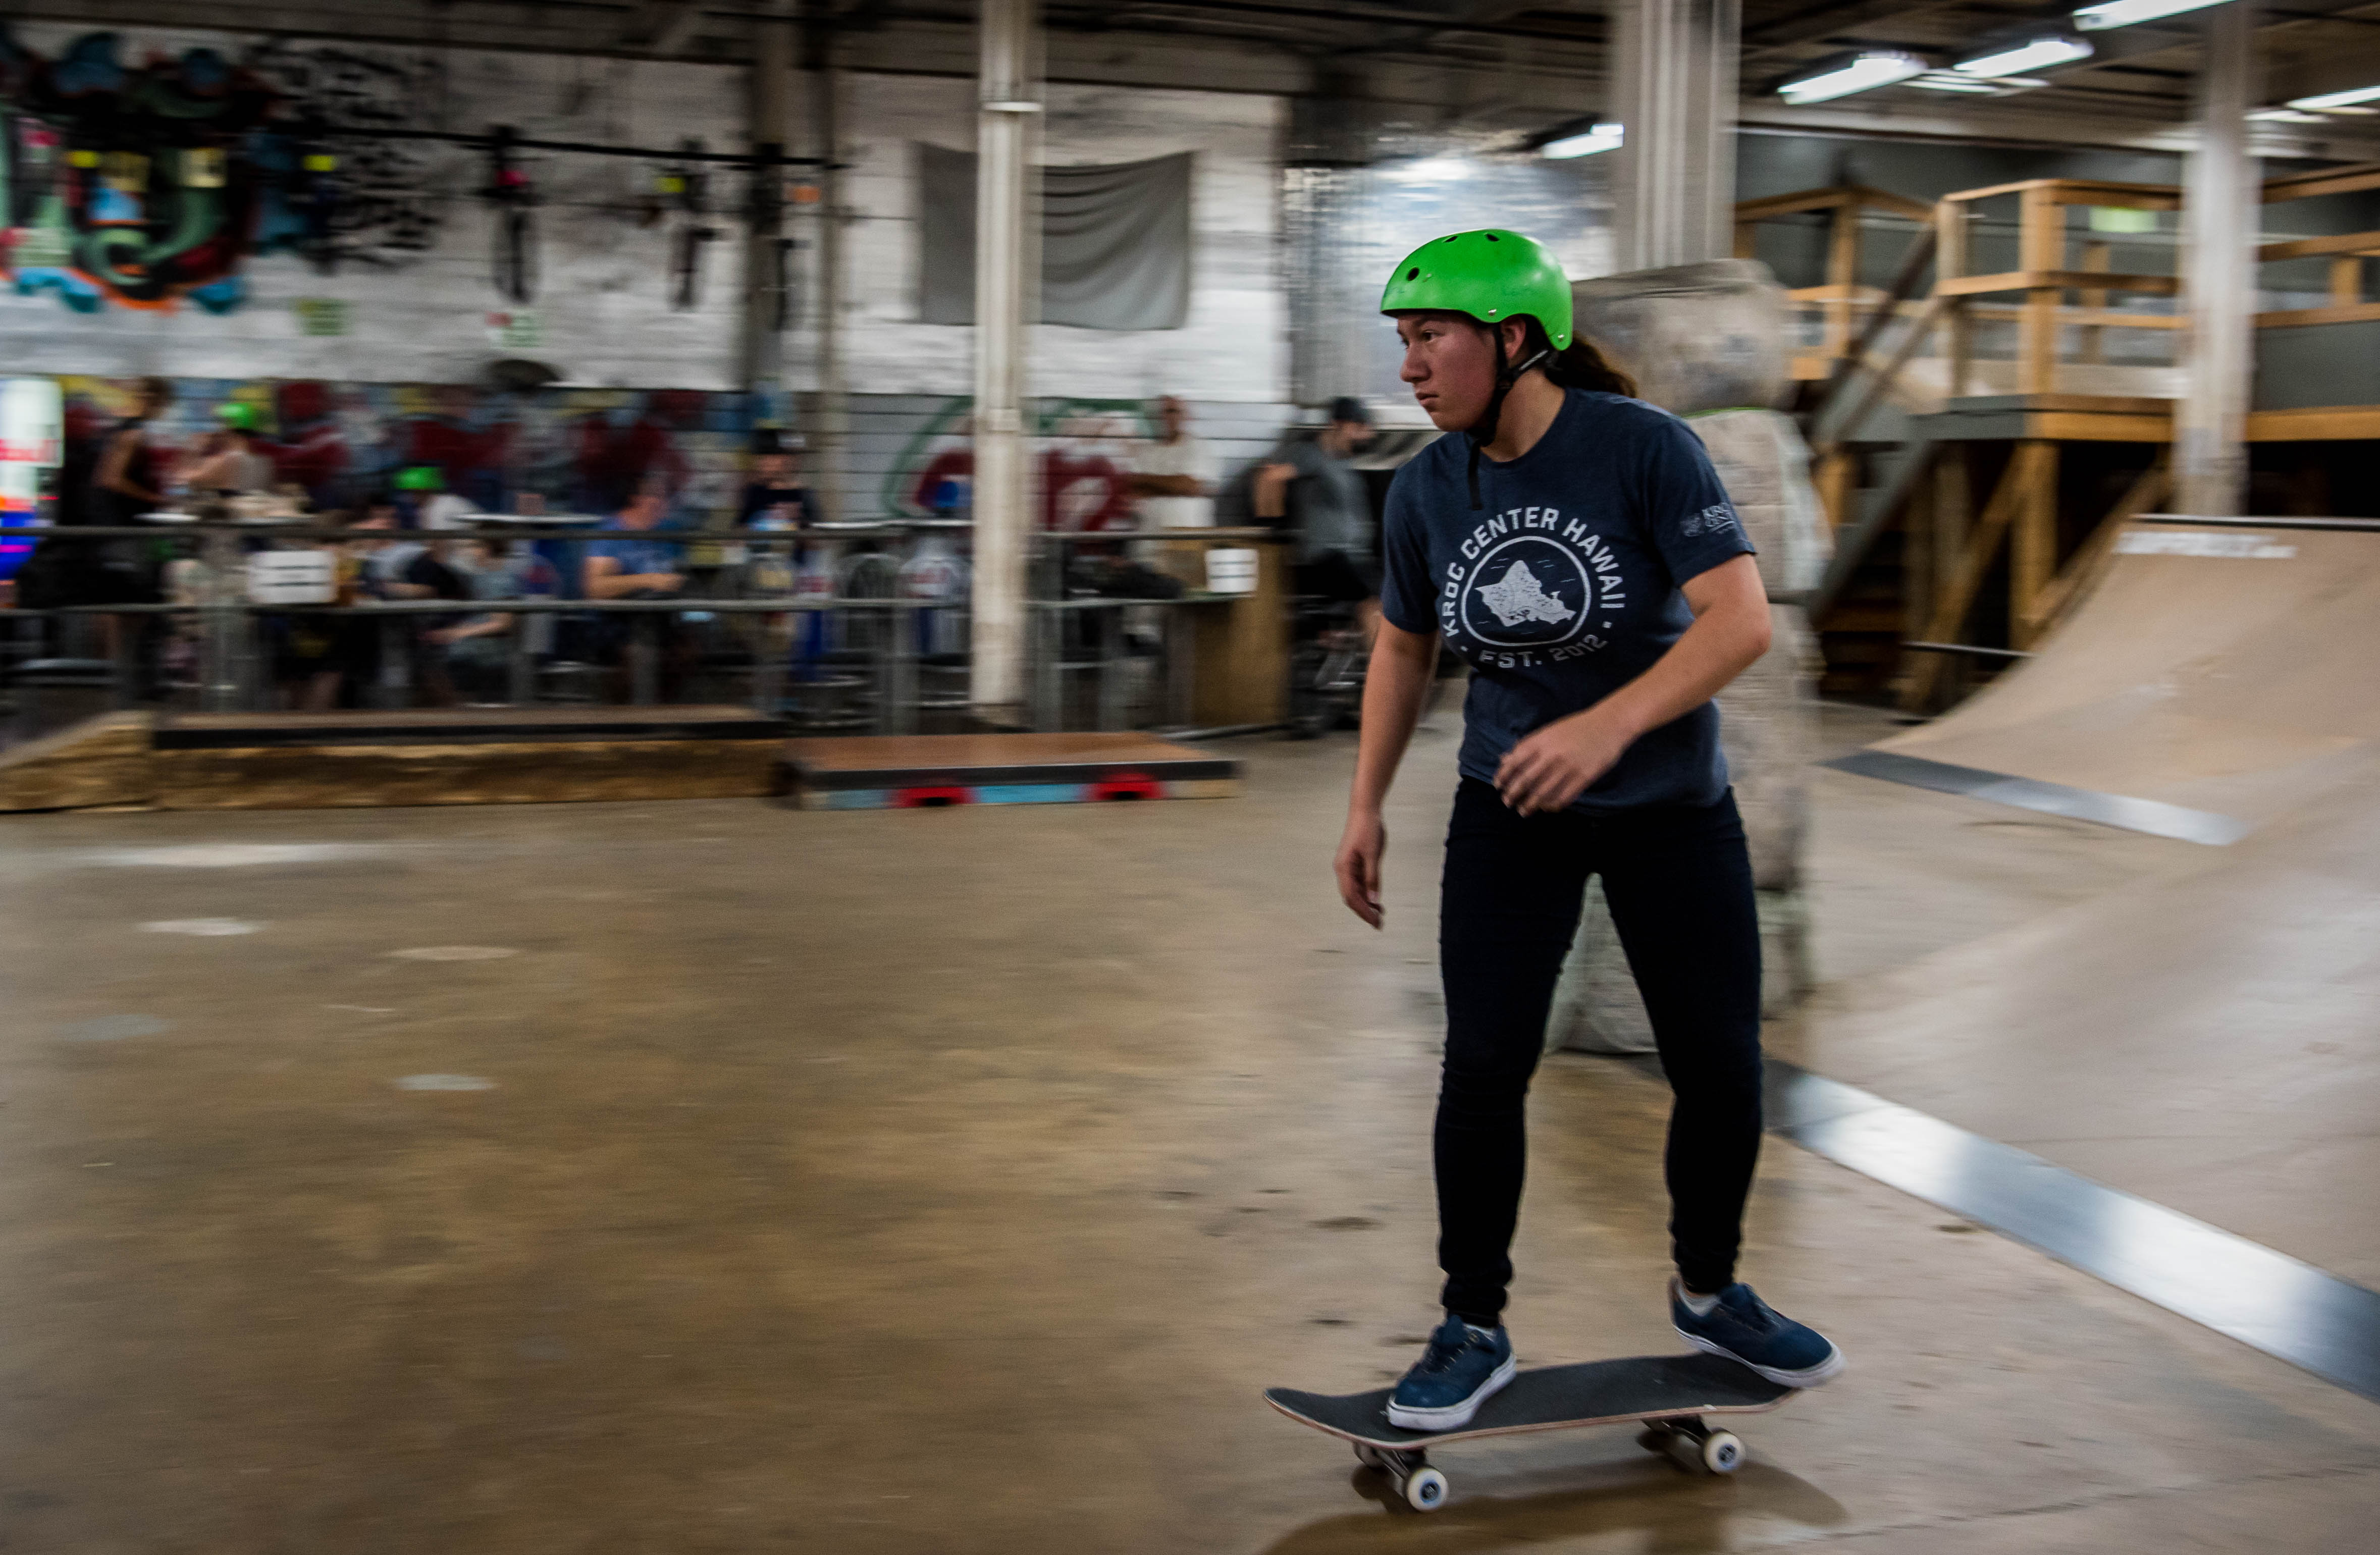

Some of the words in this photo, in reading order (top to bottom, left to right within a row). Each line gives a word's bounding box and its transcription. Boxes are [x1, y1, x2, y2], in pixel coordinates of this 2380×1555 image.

[1441, 562, 1465, 637] KROC
[1460, 506, 1559, 559] CENTER
[1562, 517, 1625, 609] HAWAII
[1478, 650, 1543, 668] EST.
[1548, 634, 1608, 661] 2012
